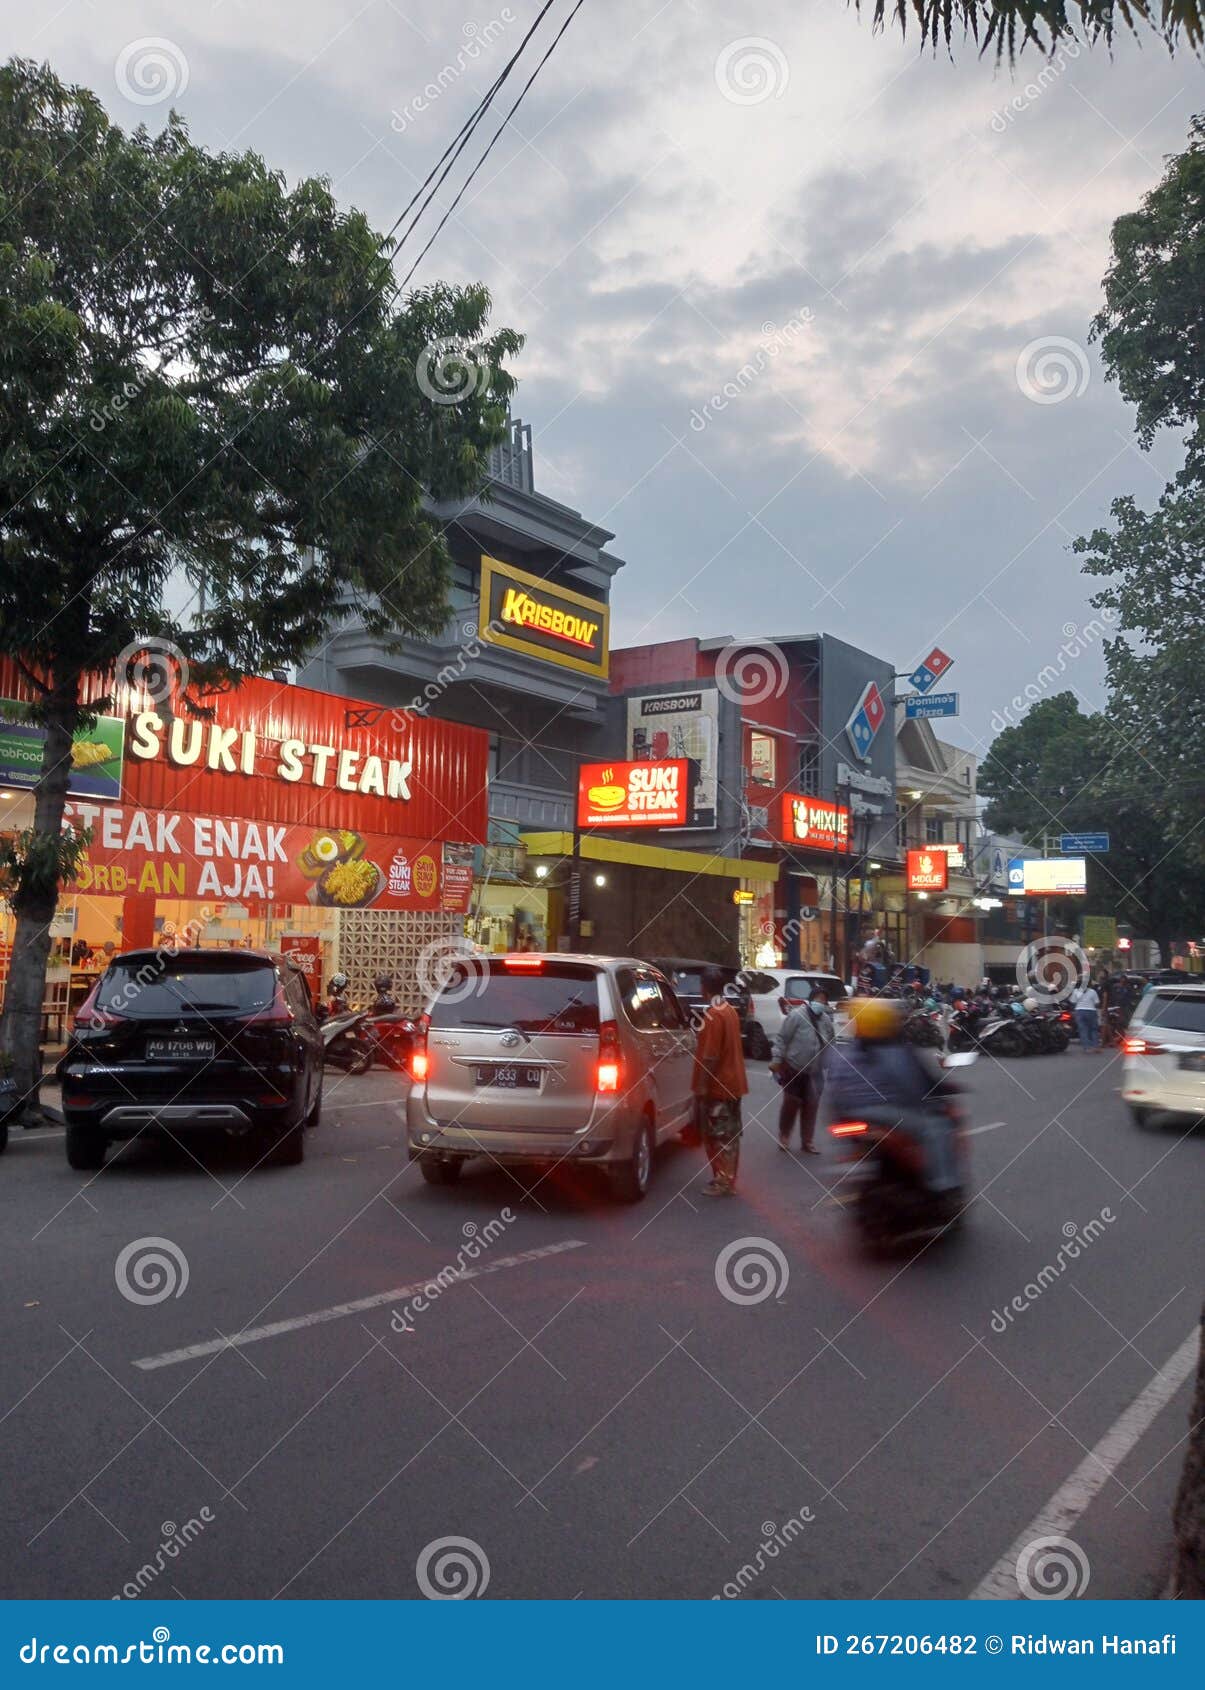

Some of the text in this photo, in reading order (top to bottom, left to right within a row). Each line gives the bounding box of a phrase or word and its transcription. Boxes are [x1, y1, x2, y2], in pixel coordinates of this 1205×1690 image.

[505, 588, 596, 643] KRISBOW
[644, 696, 698, 713] KRISBOW
[132, 711, 413, 800] SUKI STEAK
[628, 767, 679, 792] SUKI
[627, 790, 679, 811] STEAK
[809, 808, 849, 835] MIXUE
[194, 817, 288, 863] ENAK
[197, 860, 274, 900] AJA!
[388, 879, 411, 891] STEAK
[389, 864, 412, 880] SUKI
